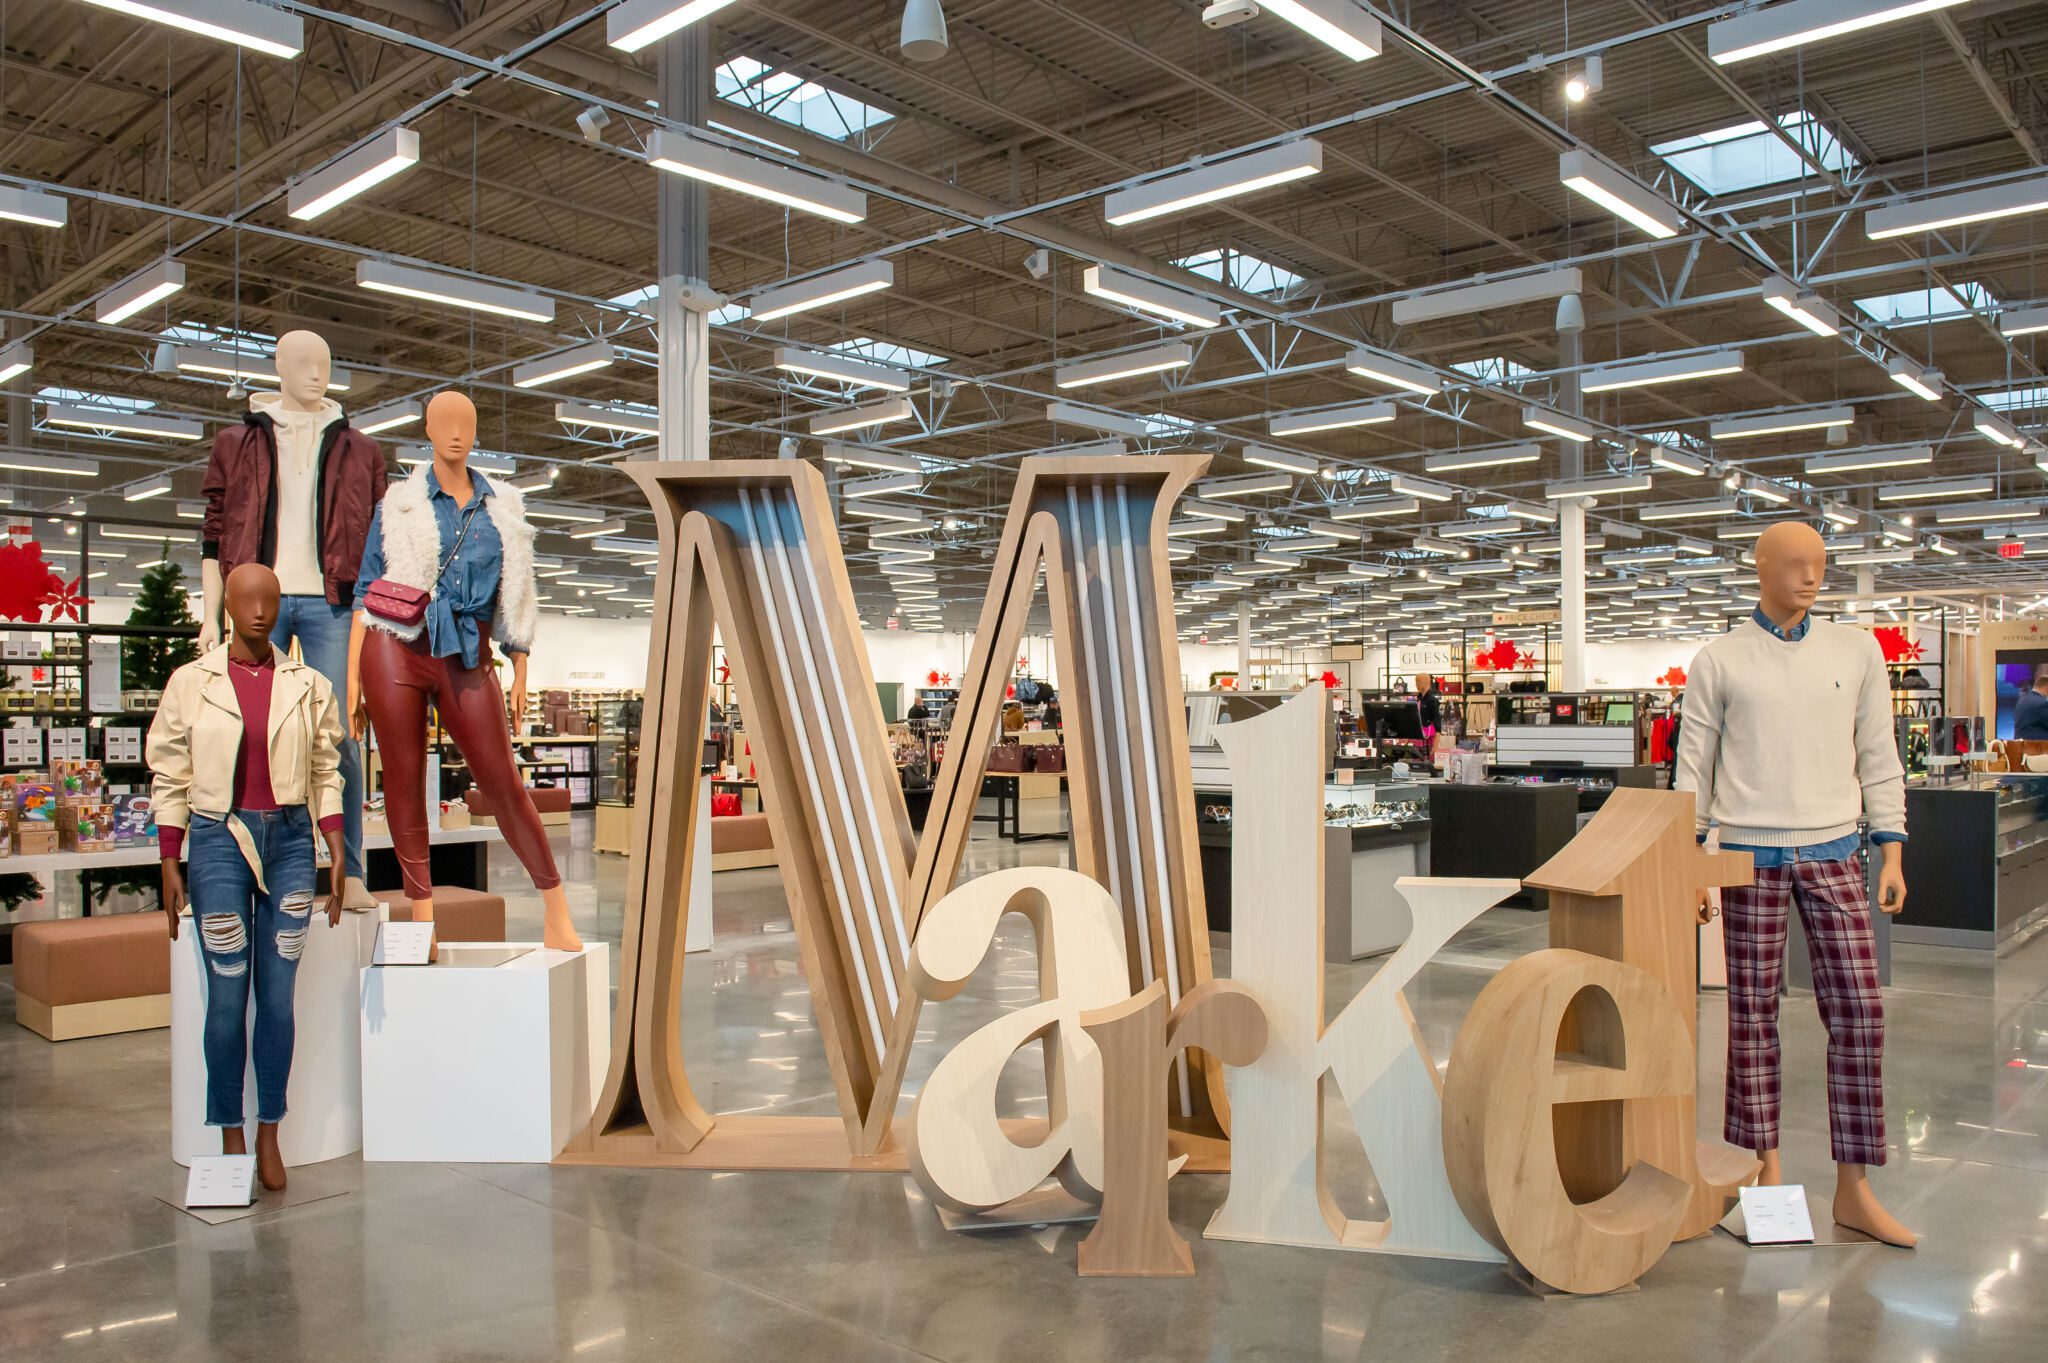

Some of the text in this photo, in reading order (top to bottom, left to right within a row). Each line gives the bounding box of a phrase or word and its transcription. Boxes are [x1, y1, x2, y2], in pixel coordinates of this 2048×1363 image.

[1530, 612, 1558, 620] CHECK
[1402, 651, 1449, 664] GUESS
[554, 455, 1763, 1296] Market
